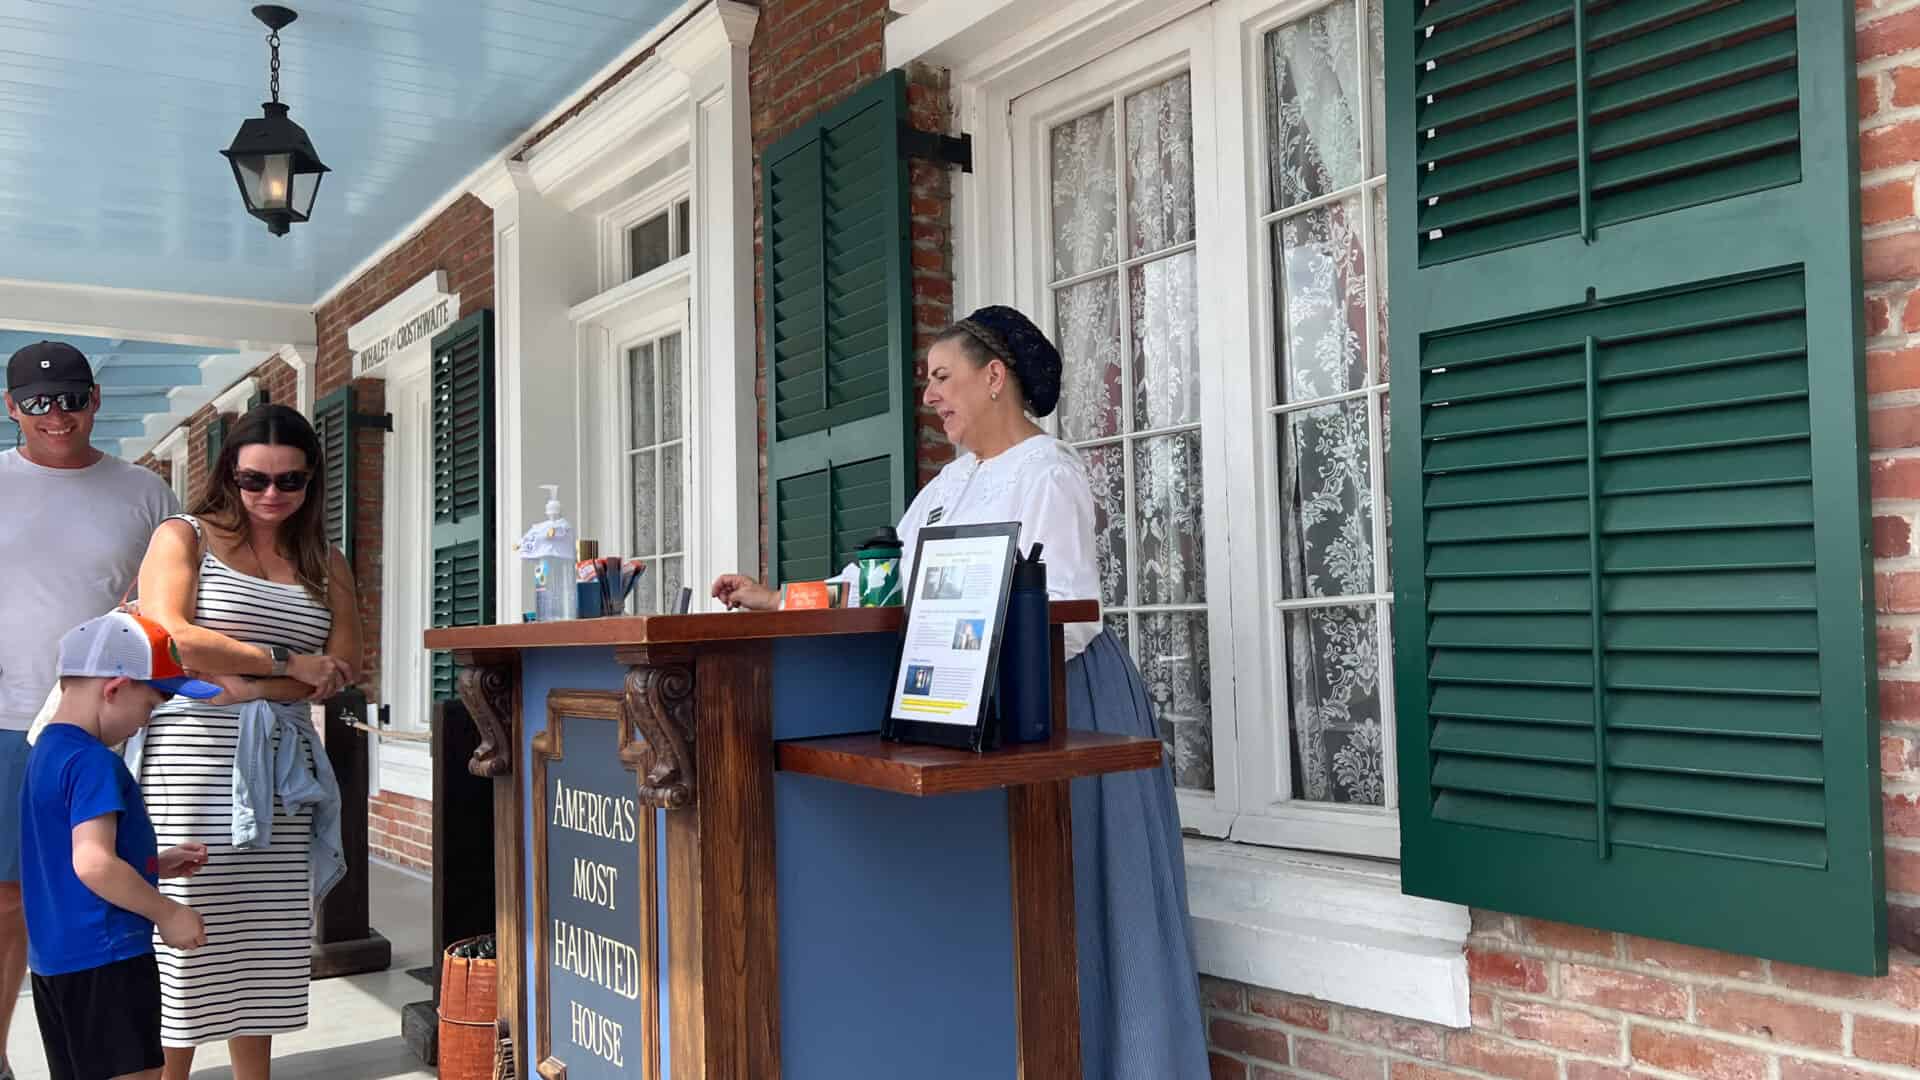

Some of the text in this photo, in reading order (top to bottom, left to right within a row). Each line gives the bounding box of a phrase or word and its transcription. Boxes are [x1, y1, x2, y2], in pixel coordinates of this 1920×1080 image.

[361, 336, 390, 372] WHALEY
[554, 778, 635, 842] AMERICA'S
[573, 857, 617, 910] MOST
[554, 919, 639, 1000] HAUNTED
[571, 1000, 624, 1067] HOUSE
